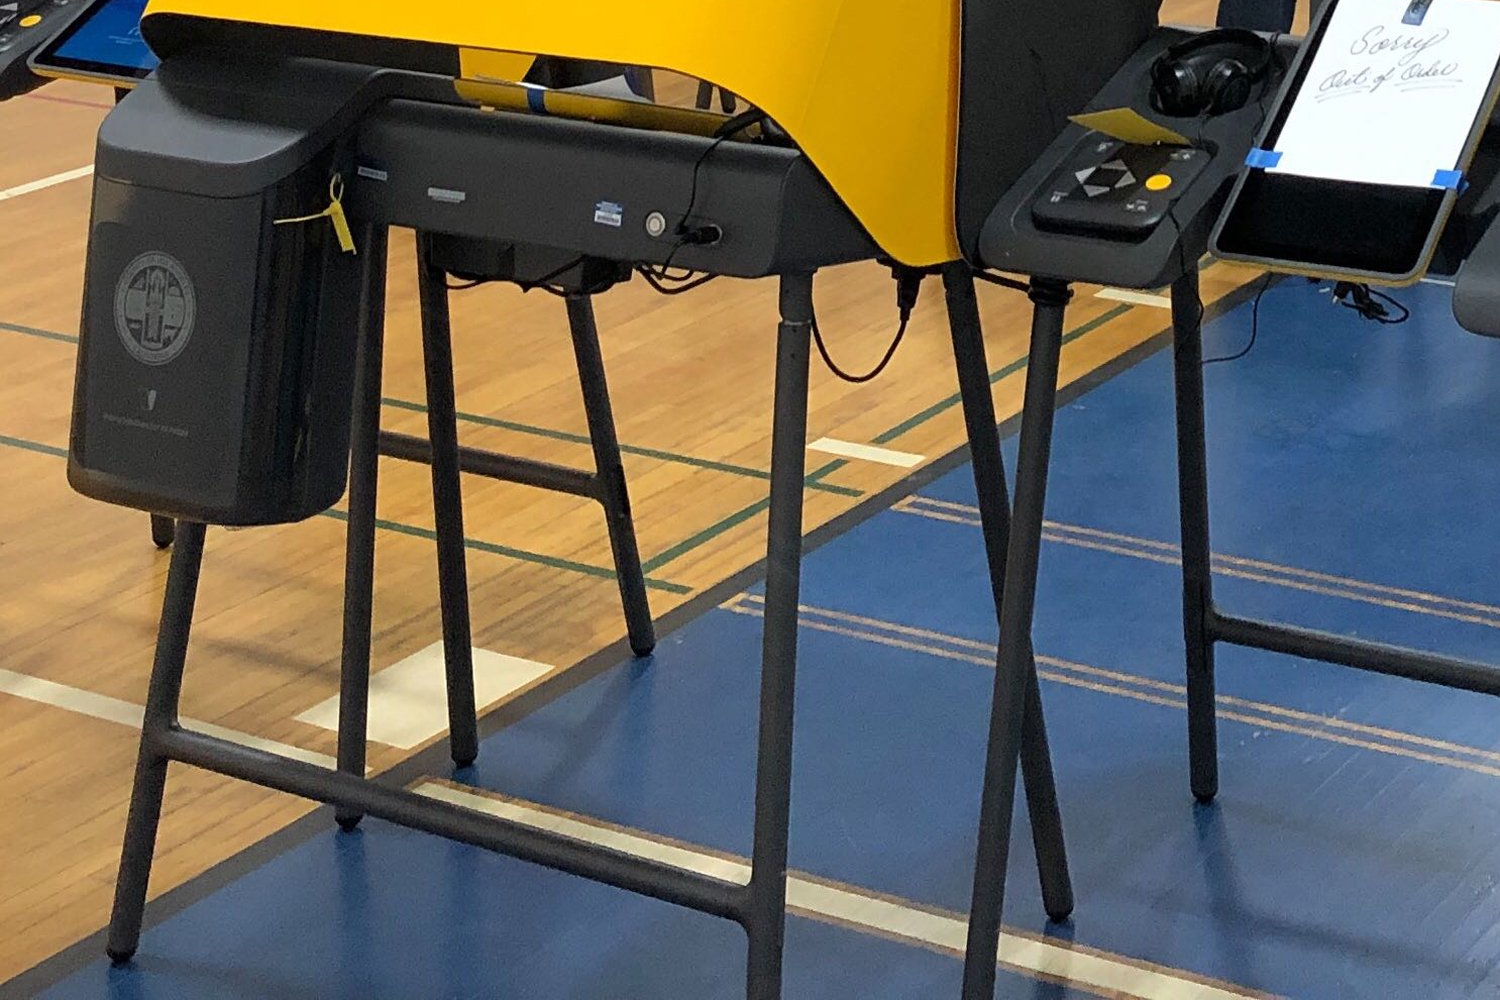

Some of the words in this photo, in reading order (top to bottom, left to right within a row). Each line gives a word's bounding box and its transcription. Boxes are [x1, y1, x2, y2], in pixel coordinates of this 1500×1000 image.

[1350, 25, 1449, 65] Sorry
[1318, 69, 1368, 92] Out
[1370, 67, 1396, 93] of
[1399, 61, 1458, 81] Order
